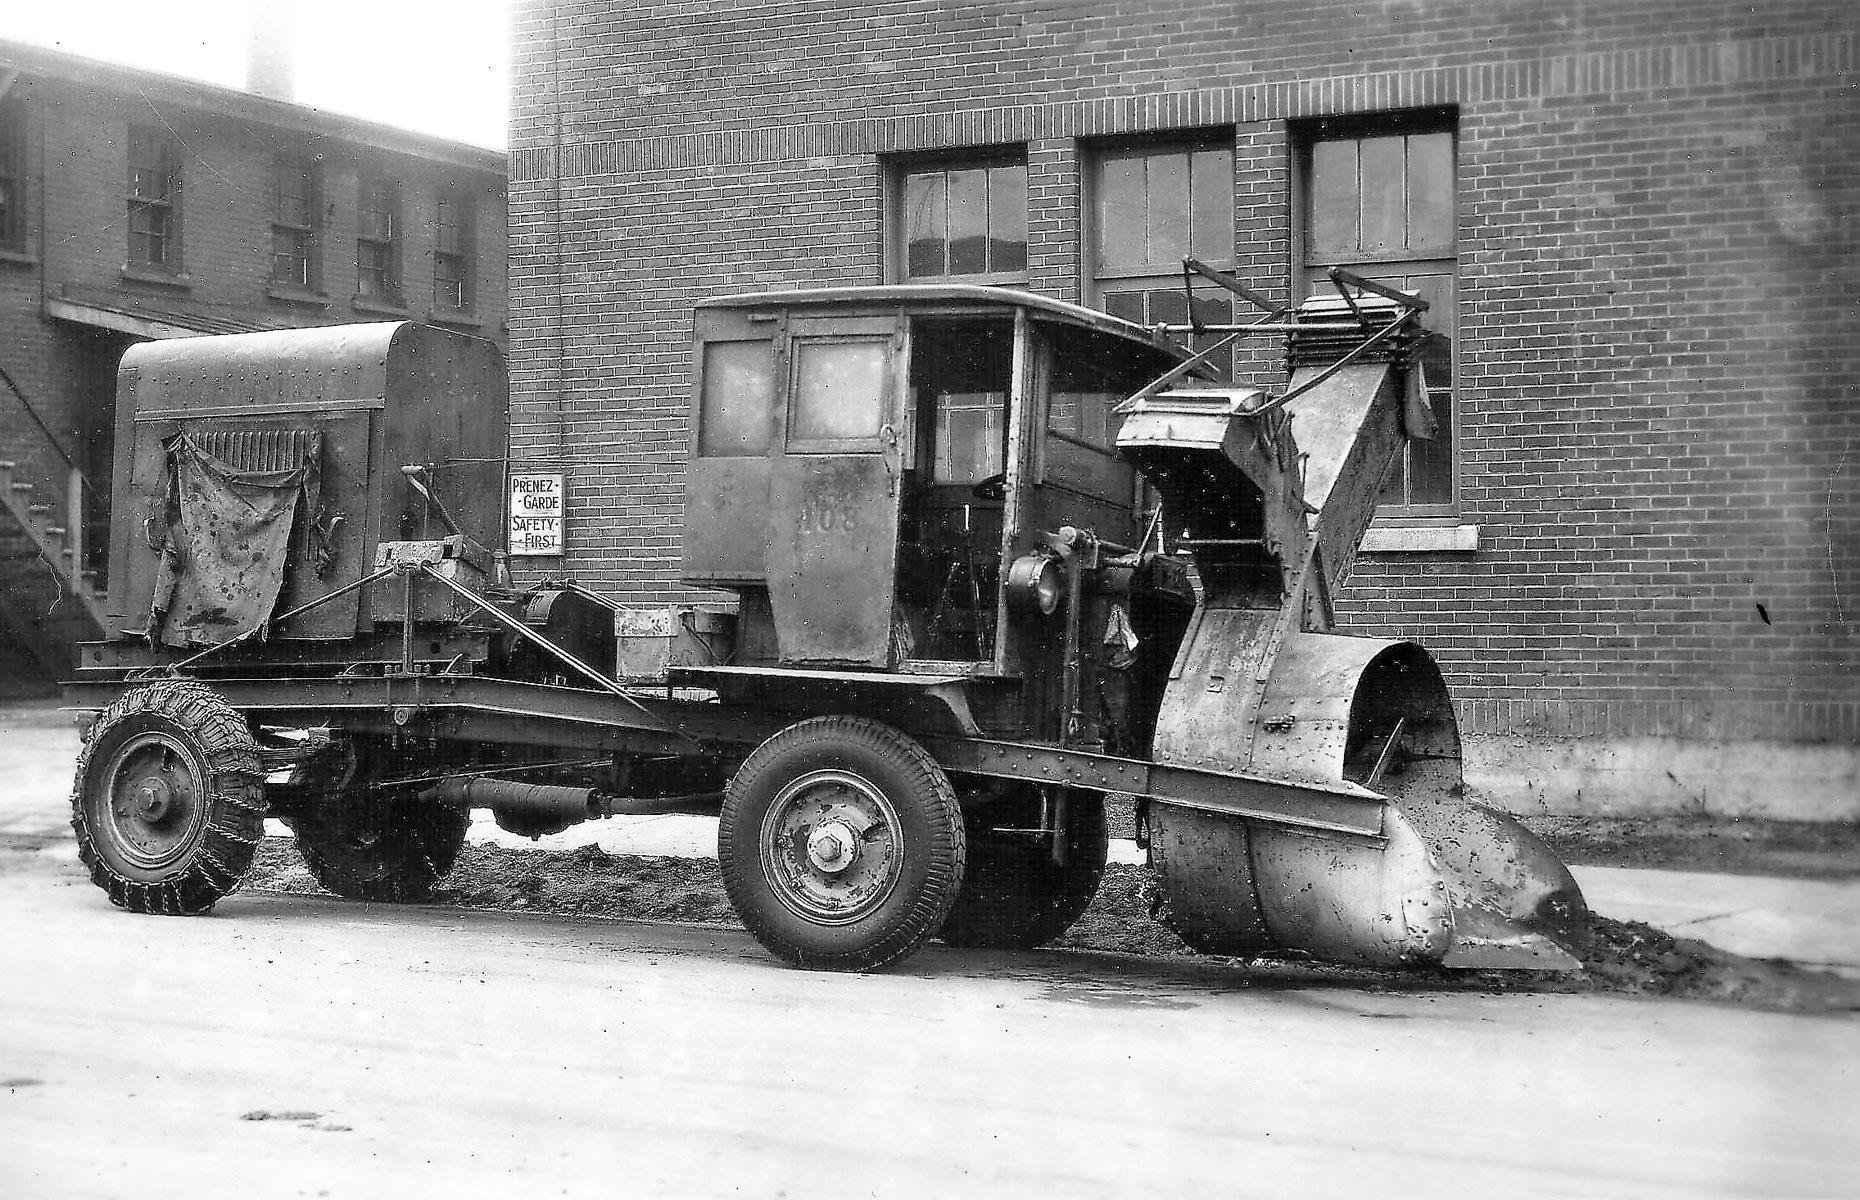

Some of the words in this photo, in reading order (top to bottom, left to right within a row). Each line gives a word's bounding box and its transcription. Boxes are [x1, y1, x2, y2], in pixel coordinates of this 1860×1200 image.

[512, 478, 553, 493] PRENEZ
[523, 494, 560, 510] GARDE
[512, 515, 555, 531] SAFETY
[525, 532, 557, 548] FIRST
